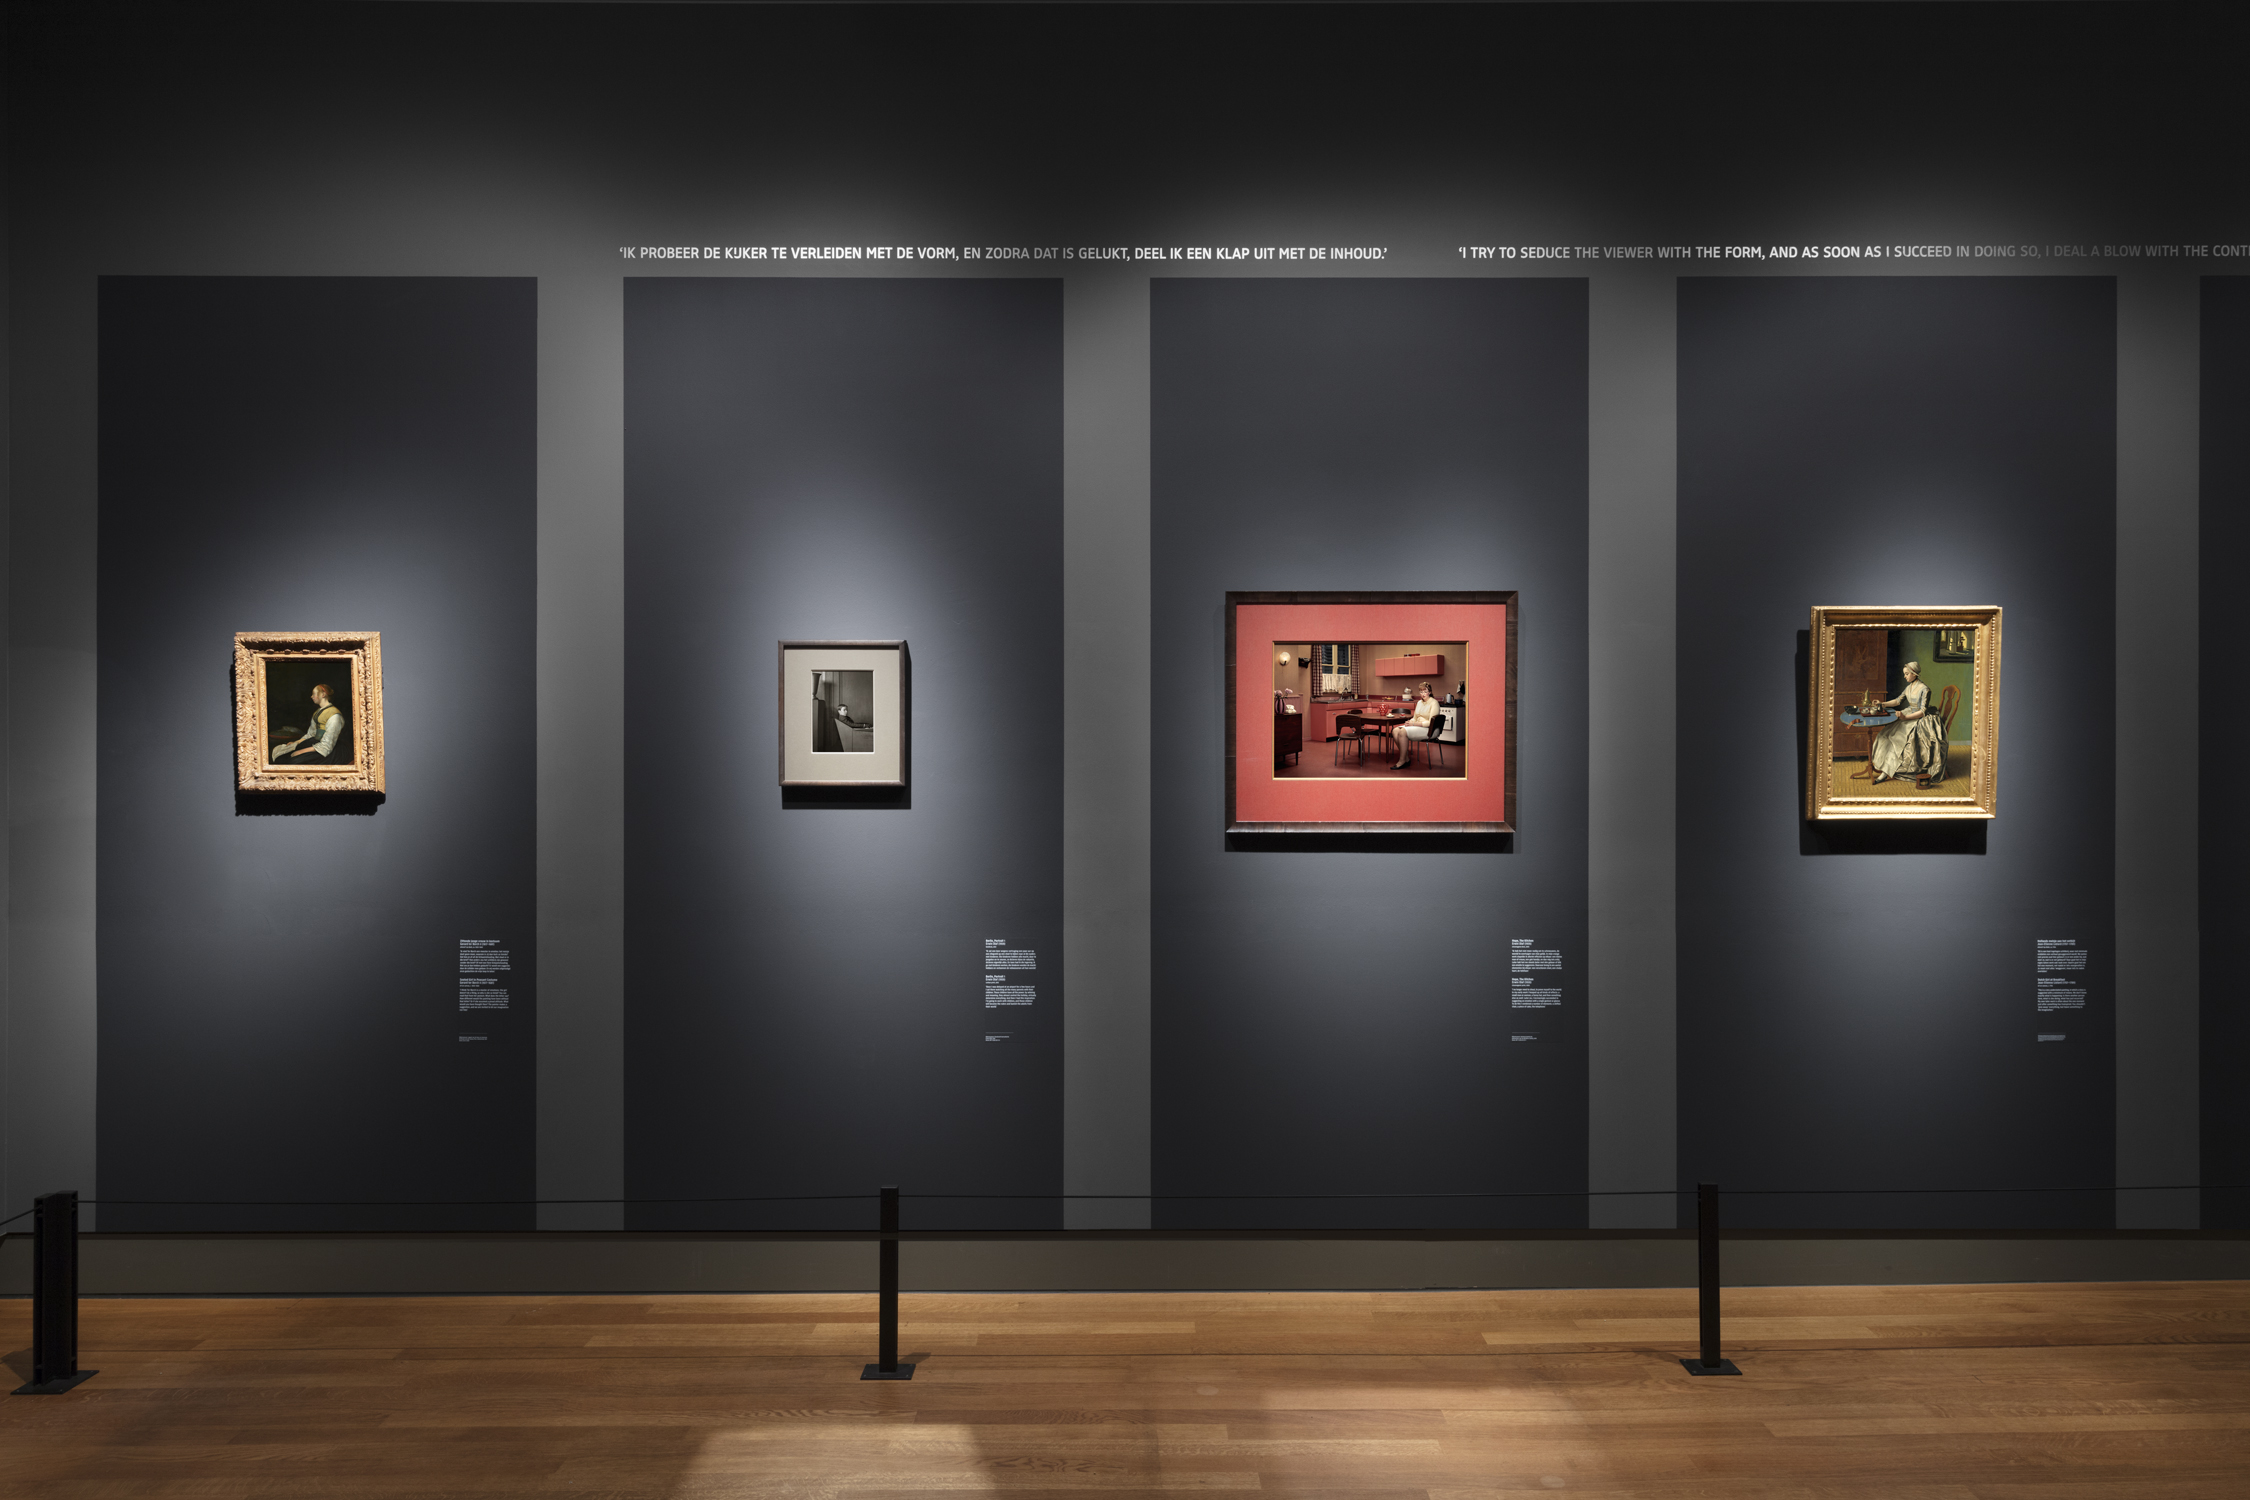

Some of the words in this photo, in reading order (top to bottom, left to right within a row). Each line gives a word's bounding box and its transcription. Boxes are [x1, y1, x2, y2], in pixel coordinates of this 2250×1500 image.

[640, 246, 700, 259] PROBEER
[703, 246, 721, 259] DE
[770, 246, 788, 260] TE
[790, 246, 862, 260] VERLEIDEN
[866, 246, 894, 259] MET
[896, 246, 914, 259] DE
[917, 246, 960, 262] VORM,
[963, 247, 981, 259] EN
[985, 247, 1030, 260] ZODRA
[1033, 247, 1059, 259] DAT
[1062, 247, 1074, 260] IS
[1078, 247, 1131, 262] GELUKT,
[1134, 247, 1167, 260] DEEL
[1170, 247, 1183, 260] IK
[1186, 247, 1212, 260] EEN
[1216, 247, 1250, 260] KLAP
[1253, 247, 1276, 260] UIT
[1278, 247, 1306, 260] MET
[1309, 247, 1327, 260] DE
[1469, 246, 1496, 259] TRY
[1498, 246, 1517, 259] TO
[1520, 246, 1571, 259] SEDUCE
[1574, 246, 1600, 259] THE
[1603, 246, 1654, 259] VIEWER
[1657, 246, 1691, 259] WITH
[1695, 246, 1721, 259] THE
[1725, 246, 1766, 261] FORM,
[1768, 246, 1798, 259] AND
[1801, 245, 1819, 259] AS
[1823, 245, 1861, 259] SOON
[1864, 245, 1882, 258] AS
[1894, 245, 1952, 258] SUCCEED
[1956, 245, 1970, 258] IN
[1974, 245, 2016, 258] DOING
[2020, 245, 2042, 260] SO,
[2054, 245, 2088, 257] DEAL
[2090, 245, 2101, 257] A
[2103, 245, 2142, 257] BLOW
[2144, 245, 2179, 257] WITH
[2182, 244, 2209, 257] THE
[2212, 244, 2250, 257] CONT
